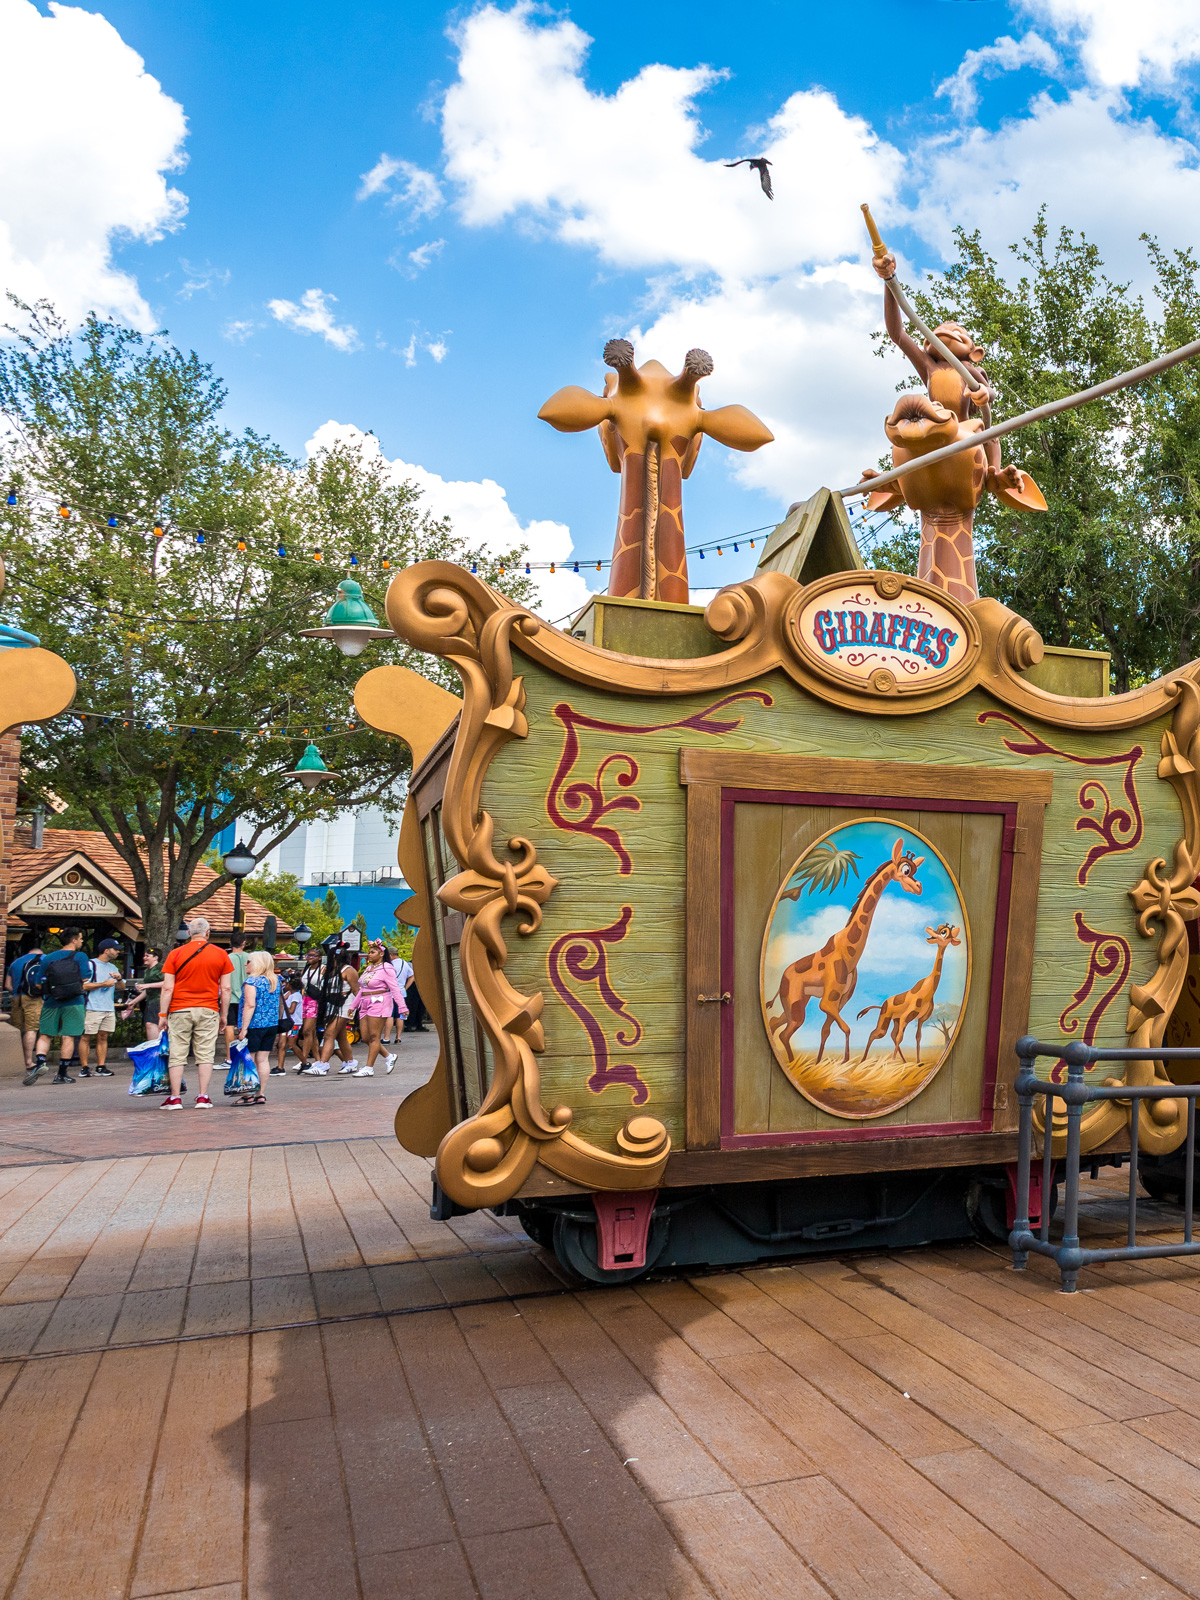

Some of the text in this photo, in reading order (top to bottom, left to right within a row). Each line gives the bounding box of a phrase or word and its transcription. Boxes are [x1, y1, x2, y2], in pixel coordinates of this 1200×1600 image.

[813, 609, 959, 669] GIRAFFES
[36, 892, 106, 907] FANTASYLAND
[48, 902, 94, 911] STATION
